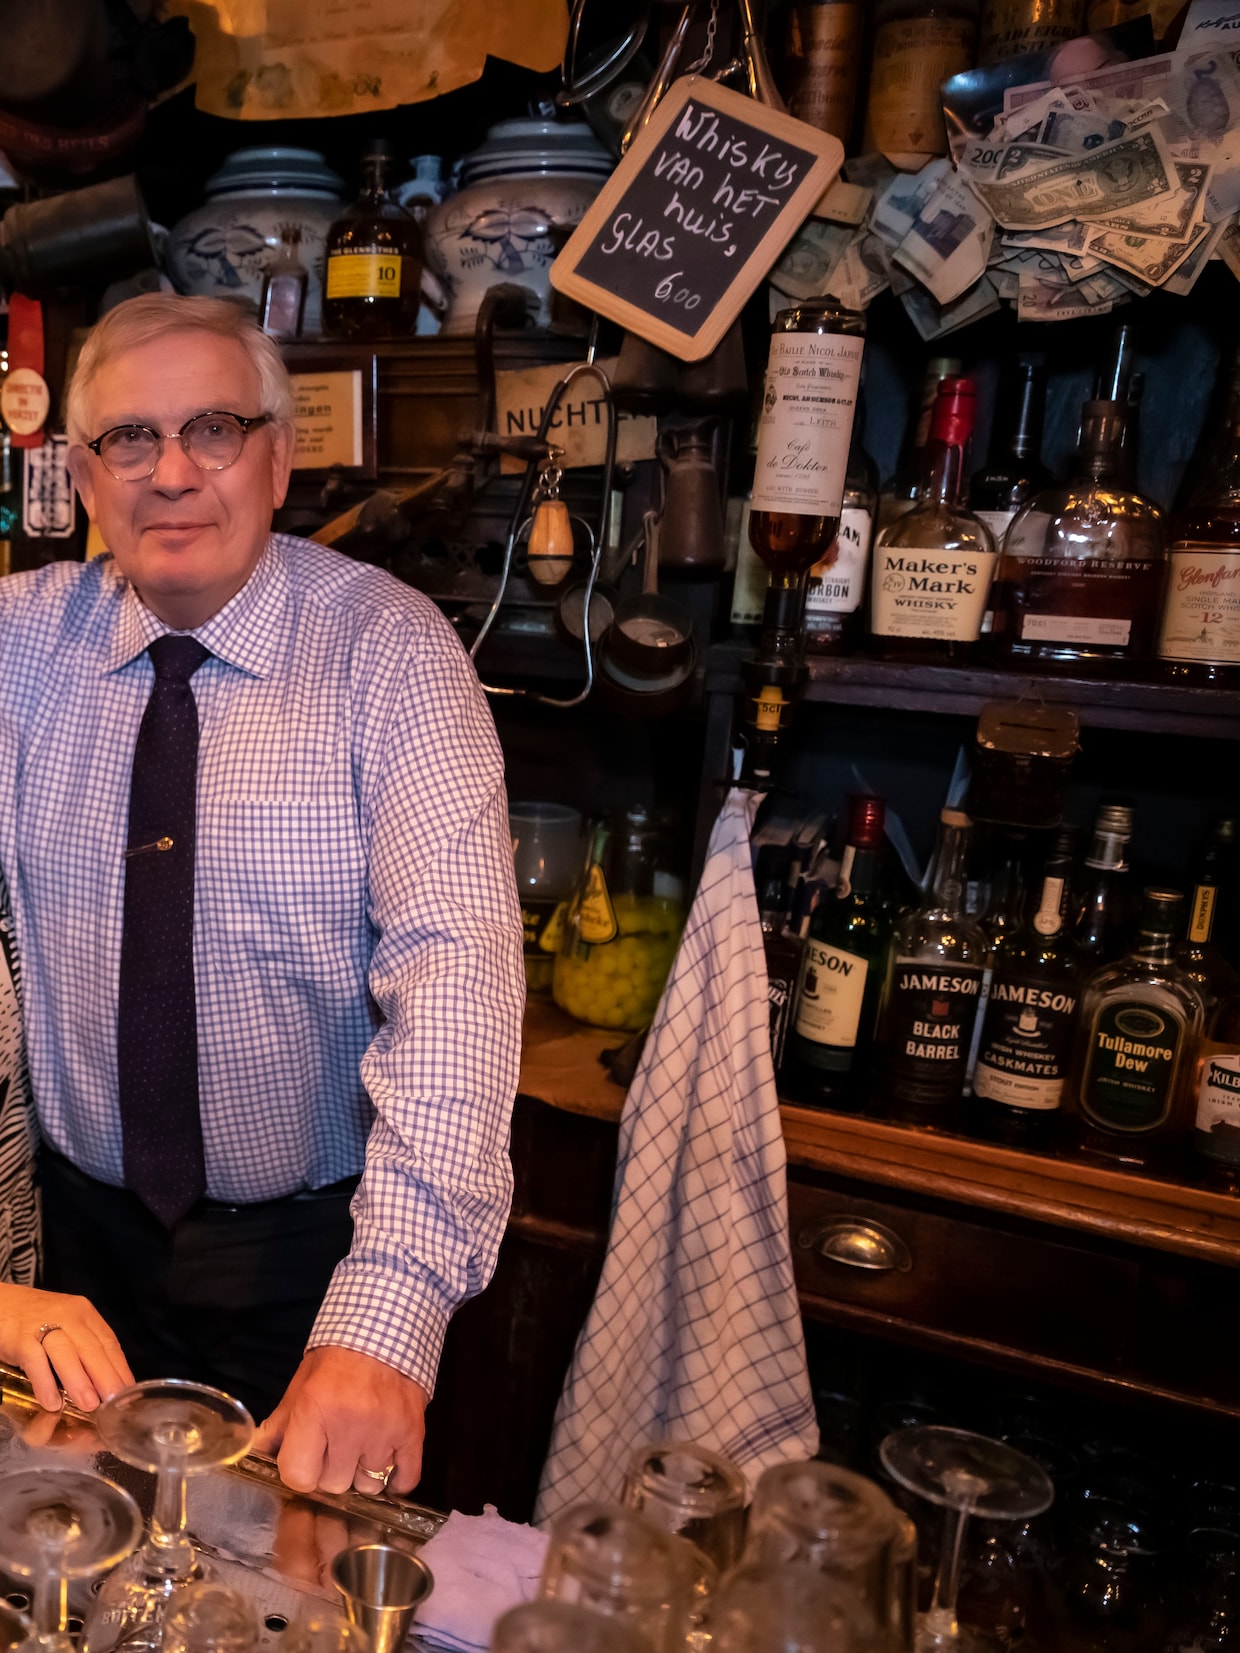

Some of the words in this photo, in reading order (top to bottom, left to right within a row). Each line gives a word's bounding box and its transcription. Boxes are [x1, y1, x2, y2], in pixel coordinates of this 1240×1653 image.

[378, 266, 396, 280] 10
[808, 344, 836, 357] NICOL
[766, 456, 779, 468] de
[842, 525, 861, 548] AM
[884, 556, 978, 576] Maker's
[1017, 556, 1087, 568] WOODFORD
[1091, 560, 1151, 571] RESERVE
[808, 583, 850, 599] URBON
[908, 576, 976, 594] Mark
[894, 598, 959, 610] WHISKY
[1180, 602, 1215, 610] SCOTCH
[1185, 596, 1220, 604] SINGLE
[1200, 611, 1224, 624] 12
[762, 703, 780, 713] 5cl
[809, 946, 854, 978] ESON
[900, 974, 980, 996] JAMESON
[990, 983, 1077, 1015] JAMESON
[913, 1021, 960, 1040] BLACK
[906, 1040, 960, 1060] BARREL
[1015, 1047, 1057, 1061] WHISKEY
[1098, 1032, 1173, 1061] Tullamore
[984, 1051, 1059, 1076] CASKMATES
[1115, 1052, 1149, 1073] Dew
